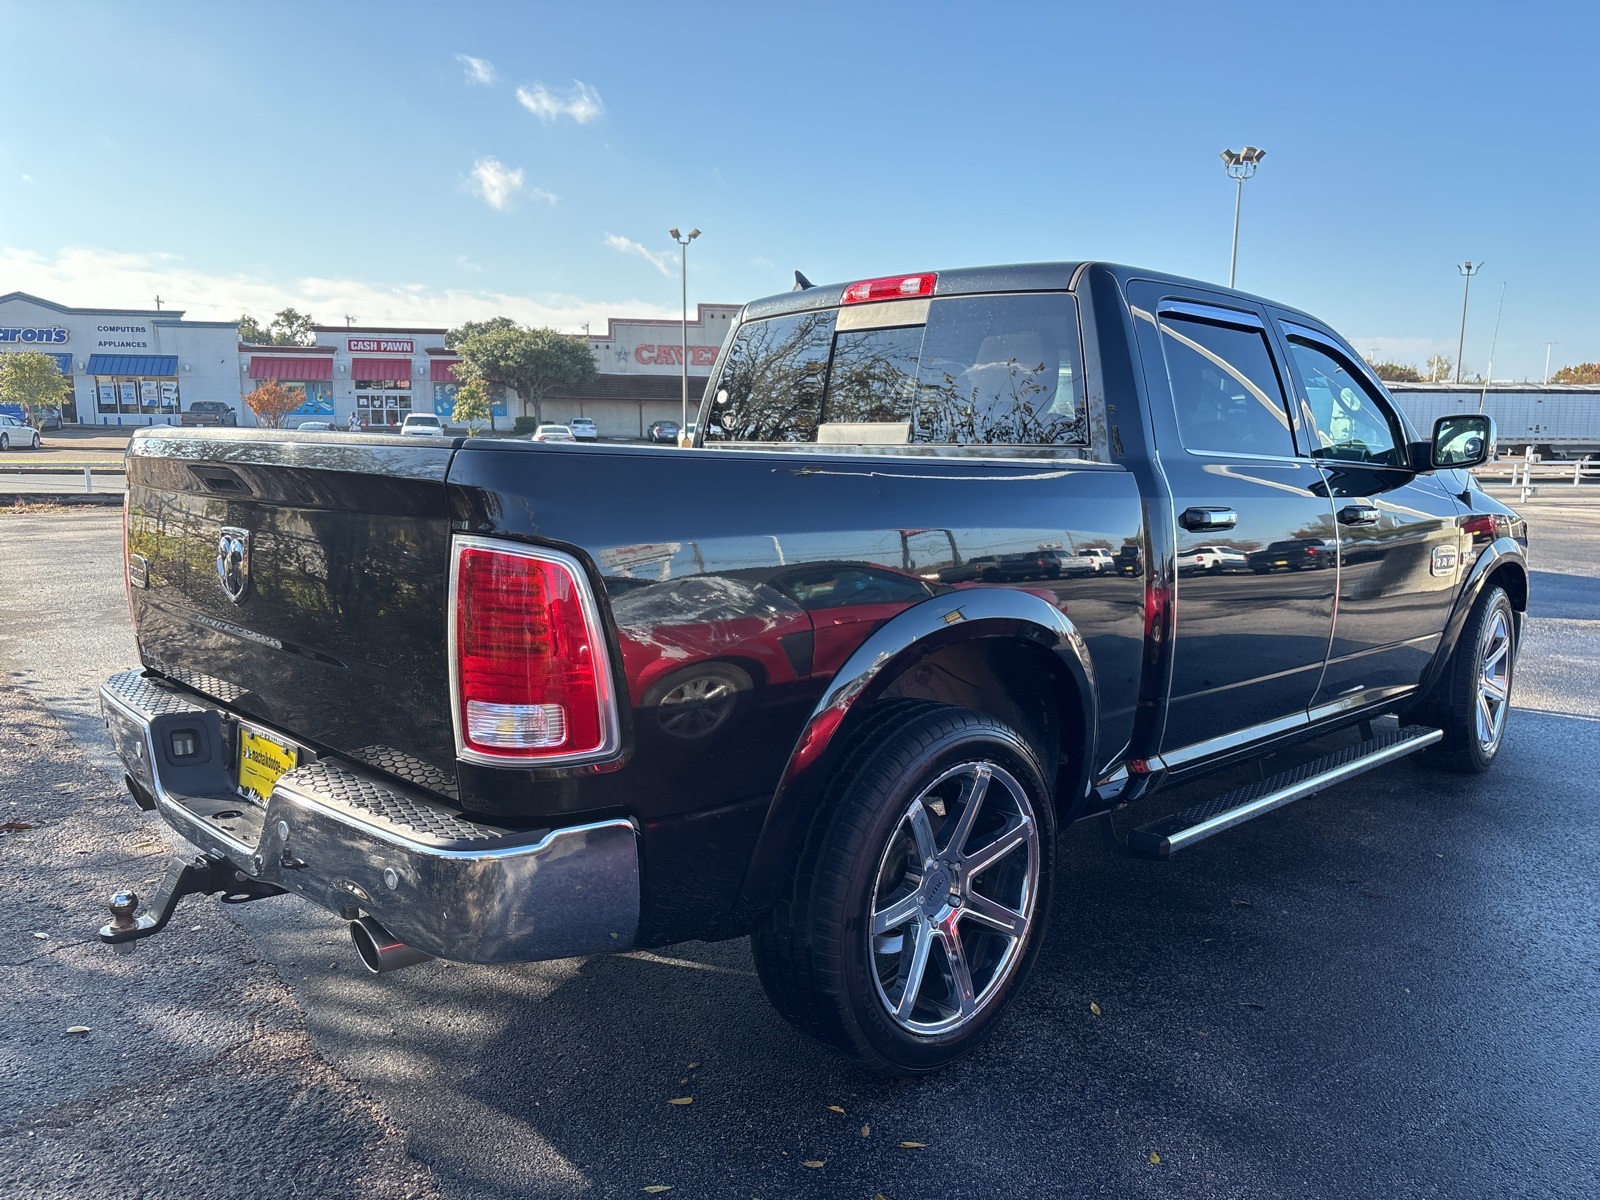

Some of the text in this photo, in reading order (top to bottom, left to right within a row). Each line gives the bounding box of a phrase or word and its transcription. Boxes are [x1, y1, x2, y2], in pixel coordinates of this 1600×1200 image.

[97, 325, 146, 333] COMPUTERS
[98, 340, 147, 348] APPLIANCES
[350, 341, 411, 352] CASH PAWN
[1436, 557, 1455, 567] RAM
